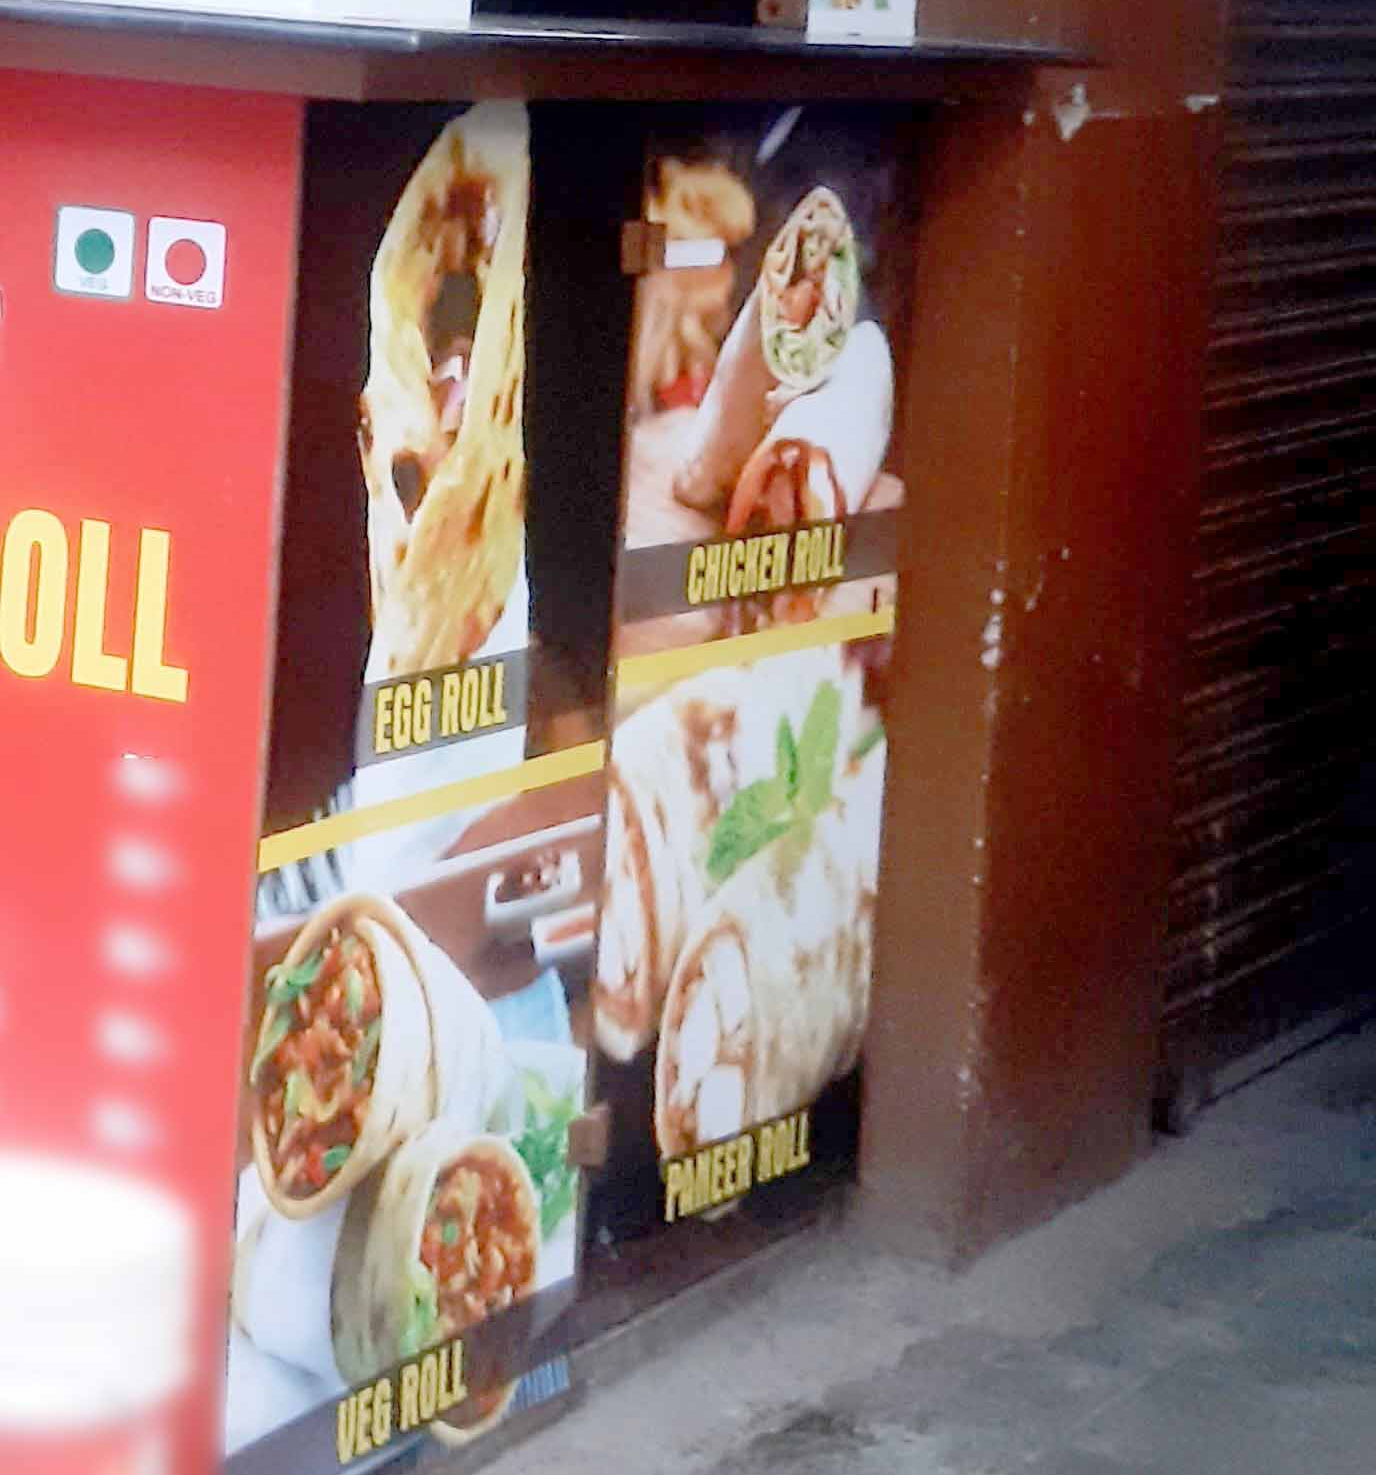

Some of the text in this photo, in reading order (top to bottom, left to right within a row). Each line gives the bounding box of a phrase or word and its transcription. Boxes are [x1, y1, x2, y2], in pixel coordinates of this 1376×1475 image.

[151, 285, 217, 304] NON-VEG
[686, 521, 846, 606] CHICKEN ROLL
[374, 661, 508, 755] EGG ROLL
[664, 1111, 811, 1223] PANEER ROLL
[336, 1377, 394, 1465] VEG
[398, 1340, 468, 1432] ROLL
